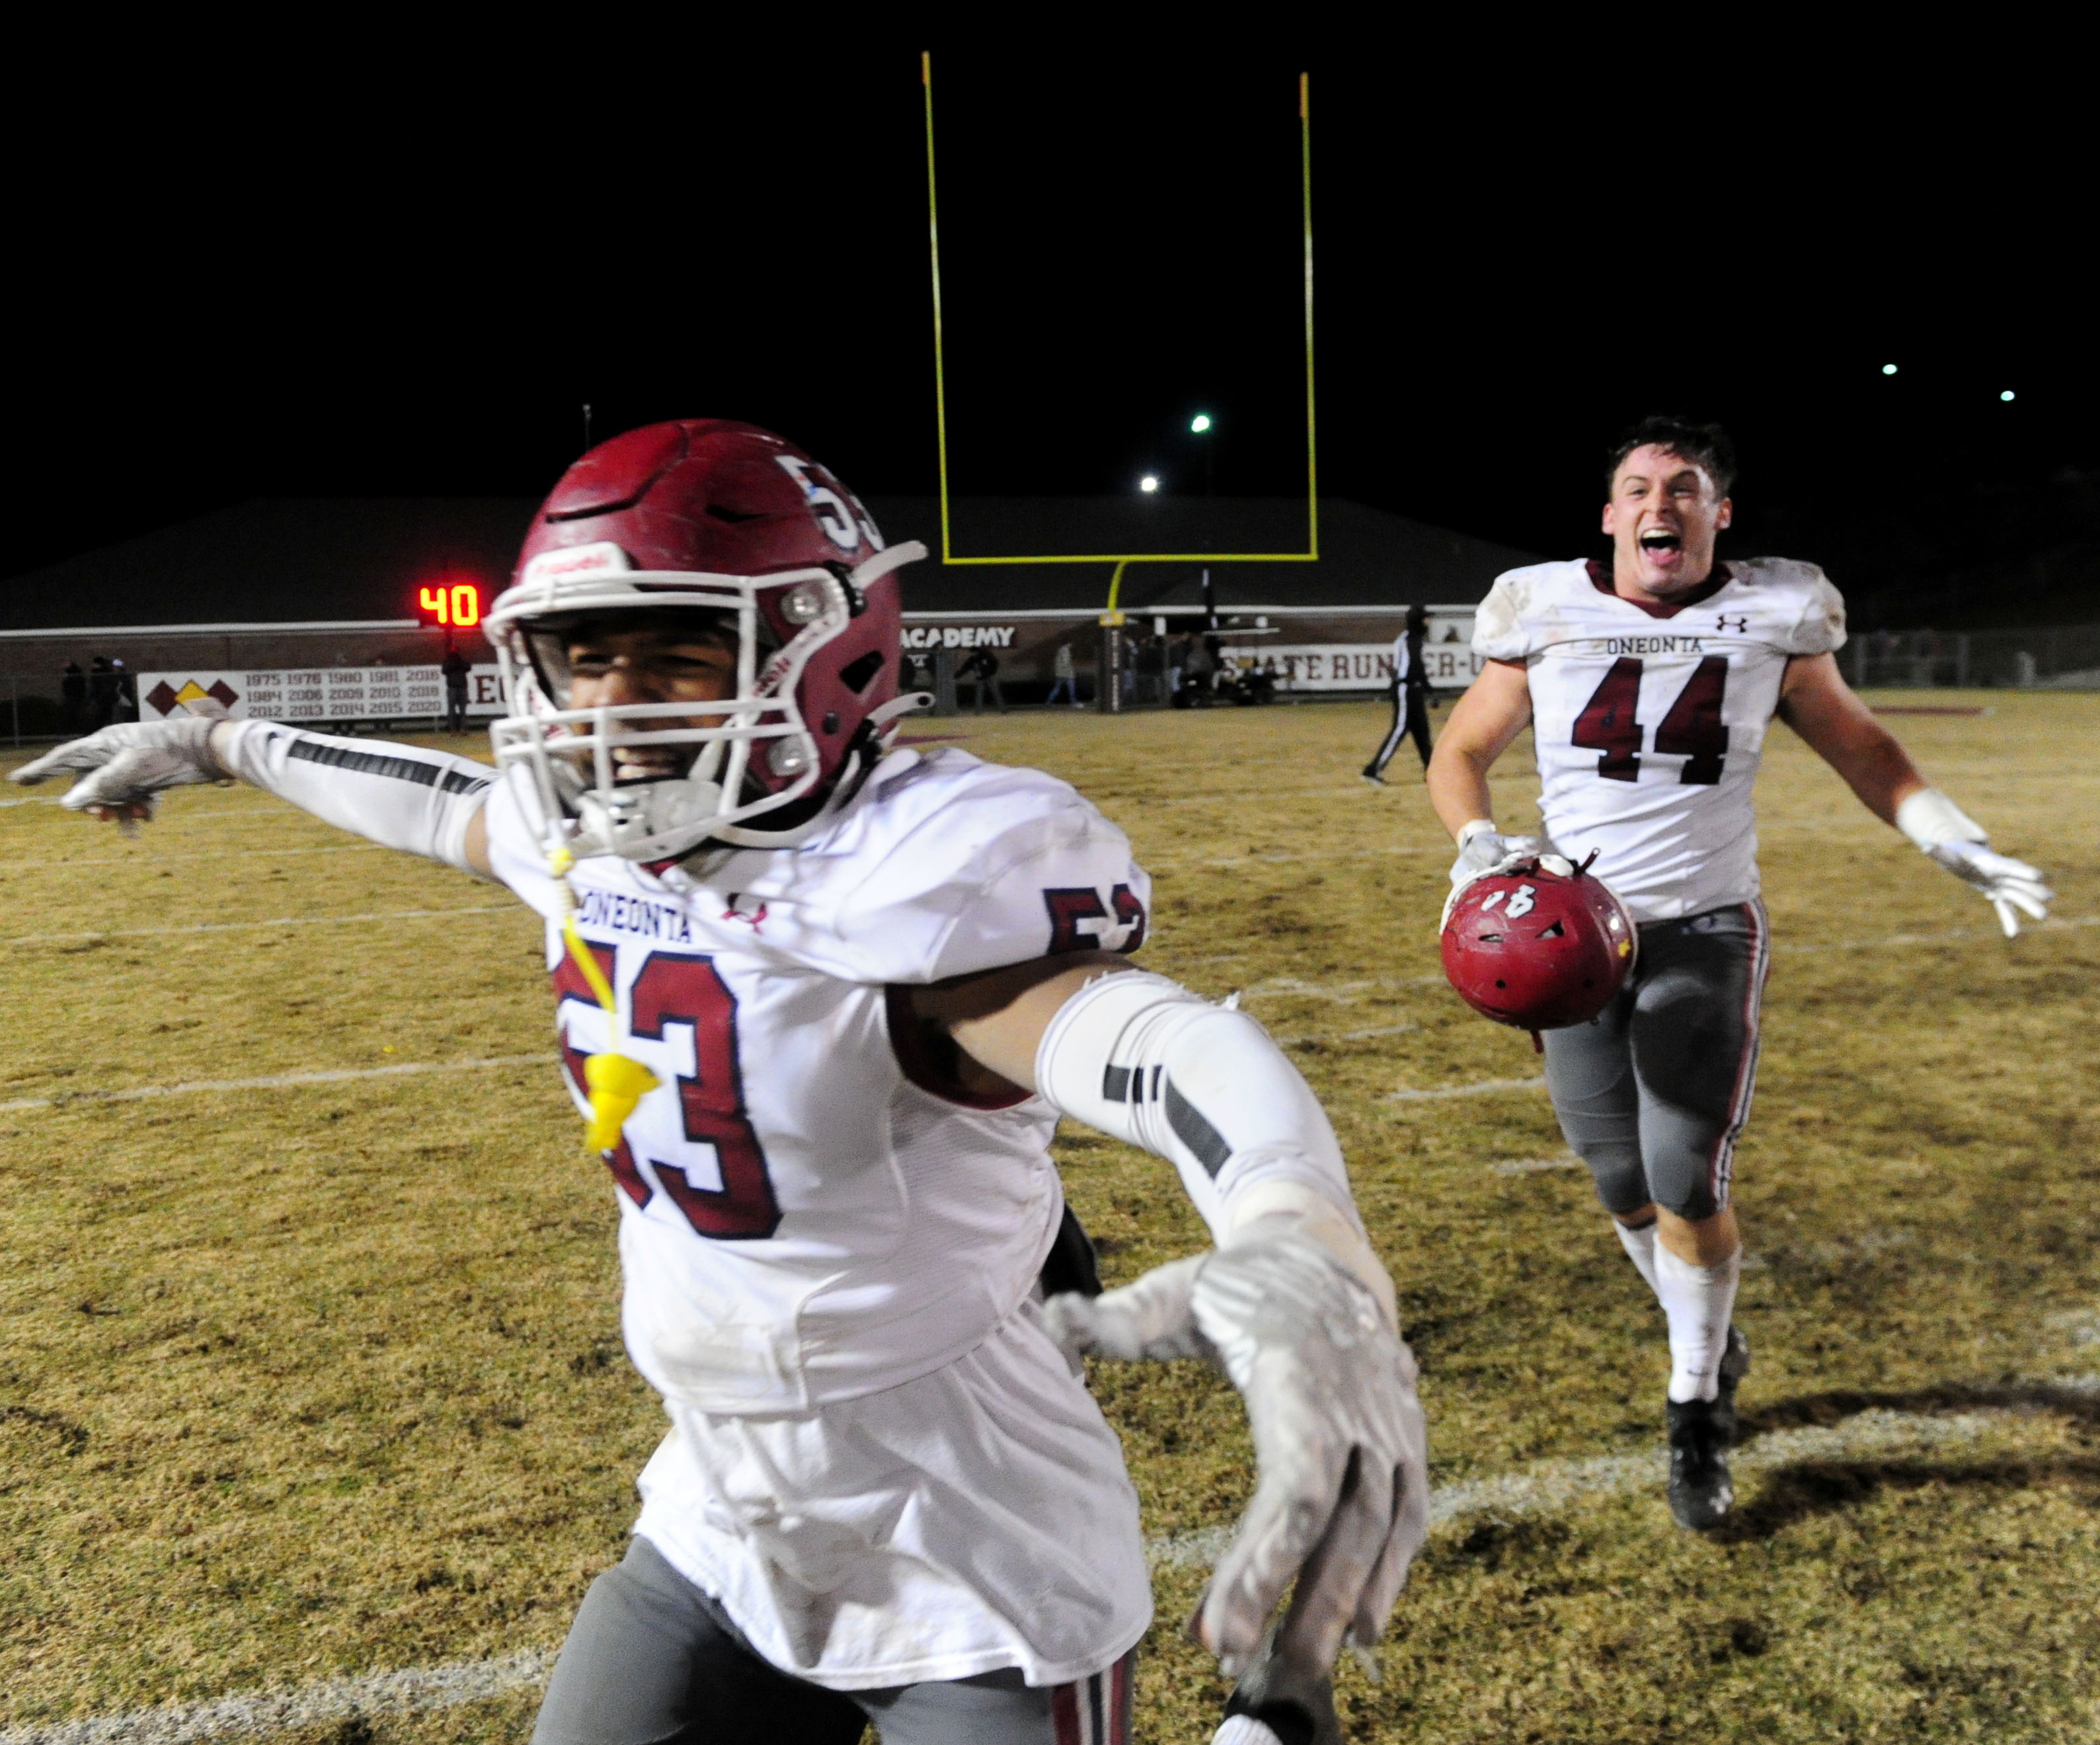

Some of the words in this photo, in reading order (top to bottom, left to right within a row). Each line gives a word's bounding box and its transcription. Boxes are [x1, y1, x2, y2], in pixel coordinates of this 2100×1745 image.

[420, 586, 479, 626] 40
[900, 627, 1015, 648] ACADEMY
[1608, 637, 1703, 654] ONEONTA
[1224, 654, 1323, 680] SATE
[246, 674, 281, 687] 1975
[248, 705, 282, 718] 2012
[290, 704, 324, 717] 2013
[330, 703, 365, 715] 2014
[369, 702, 403, 714] 2015
[1571, 655, 1730, 785] 44
[579, 890, 692, 944] ONEONTA
[551, 941, 783, 1241] 53
